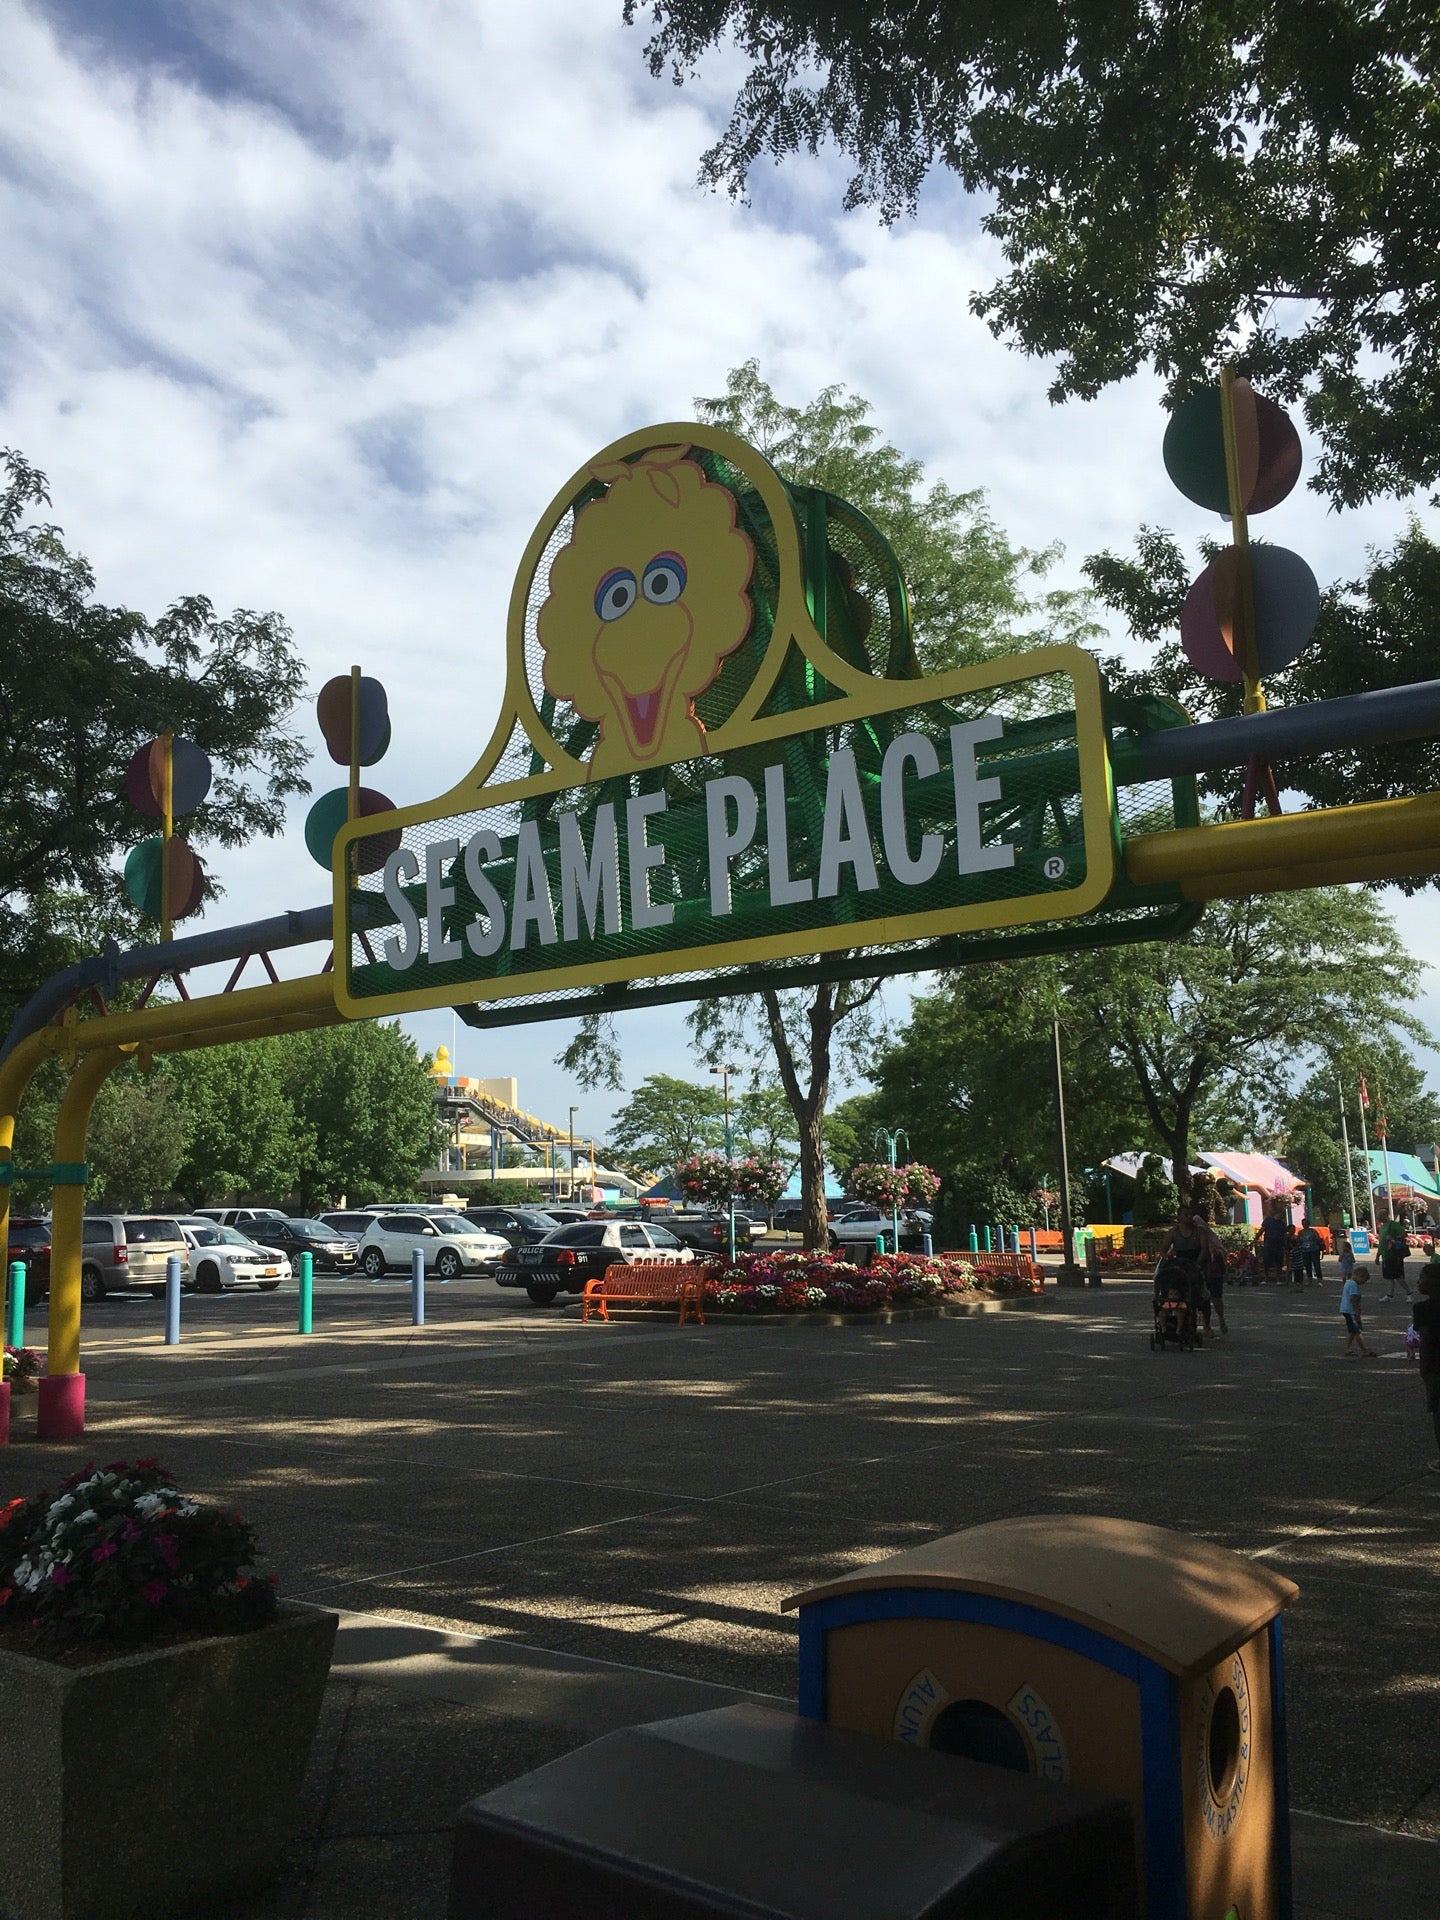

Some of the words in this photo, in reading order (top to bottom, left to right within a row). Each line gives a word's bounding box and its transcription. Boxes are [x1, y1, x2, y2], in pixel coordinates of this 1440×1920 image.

[382, 790, 675, 972] SESAME
[705, 714, 1016, 917] PLACE
[517, 1246, 545, 1254] POLICE
[577, 1255, 588, 1263] 911
